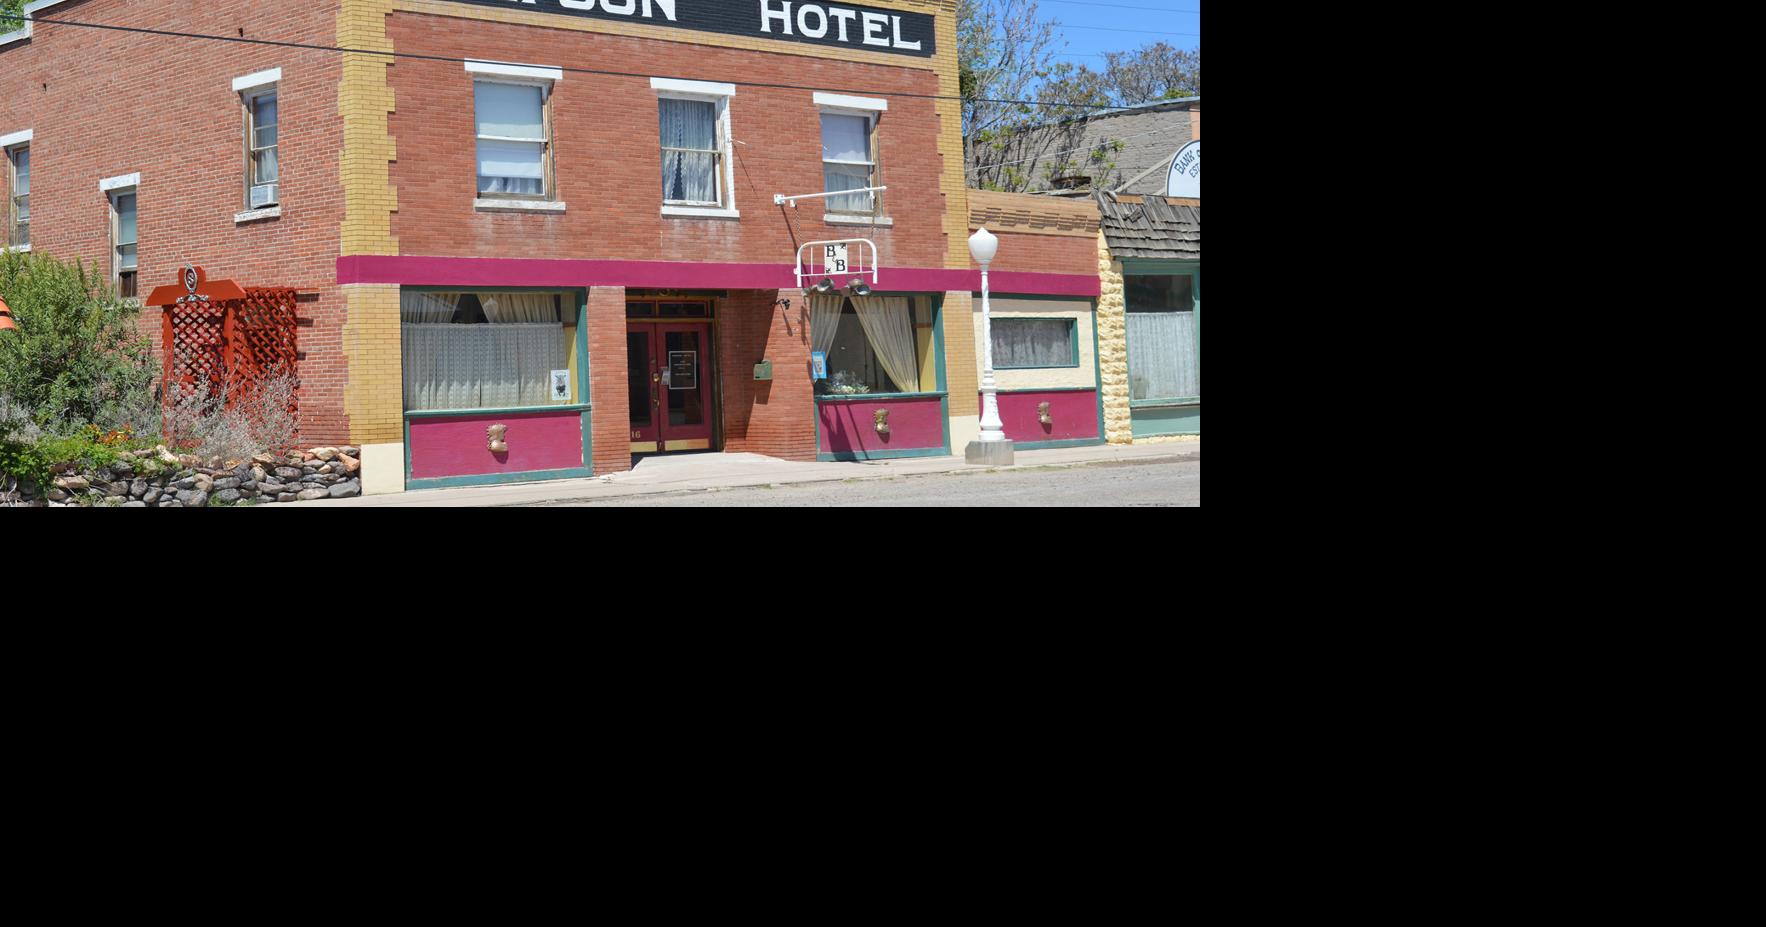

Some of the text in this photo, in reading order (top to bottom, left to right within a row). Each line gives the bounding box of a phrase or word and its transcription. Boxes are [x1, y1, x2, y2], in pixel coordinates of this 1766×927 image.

[760, 0, 921, 50] HOTEL
[1174, 149, 1195, 175] BANK
[826, 245, 836, 257] B
[836, 259, 846, 272] B
